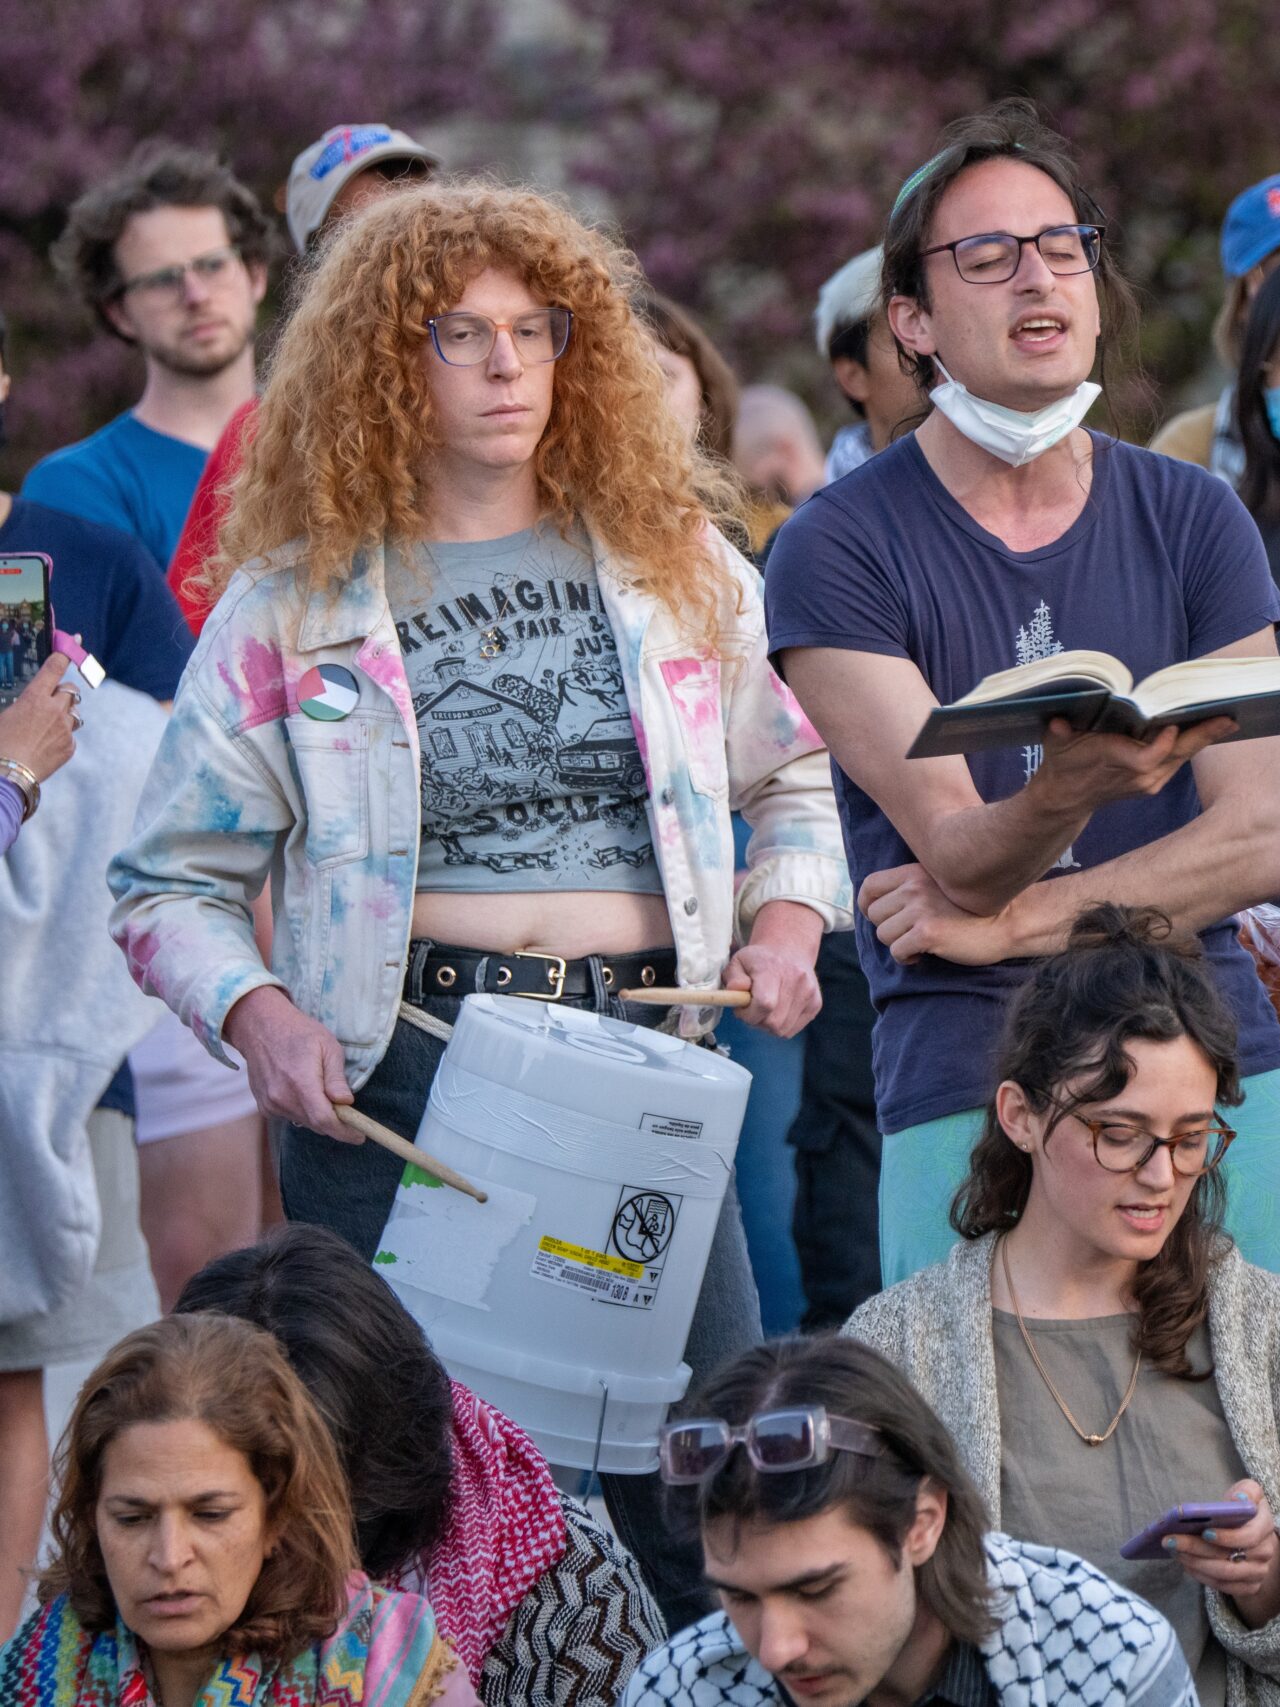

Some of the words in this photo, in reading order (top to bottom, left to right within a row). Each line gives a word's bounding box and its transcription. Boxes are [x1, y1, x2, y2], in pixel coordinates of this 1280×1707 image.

[514, 617, 565, 640] FAIR
[588, 615, 606, 632] &
[433, 711, 470, 720] FREEDOM
[472, 704, 501, 717] SCHOOL
